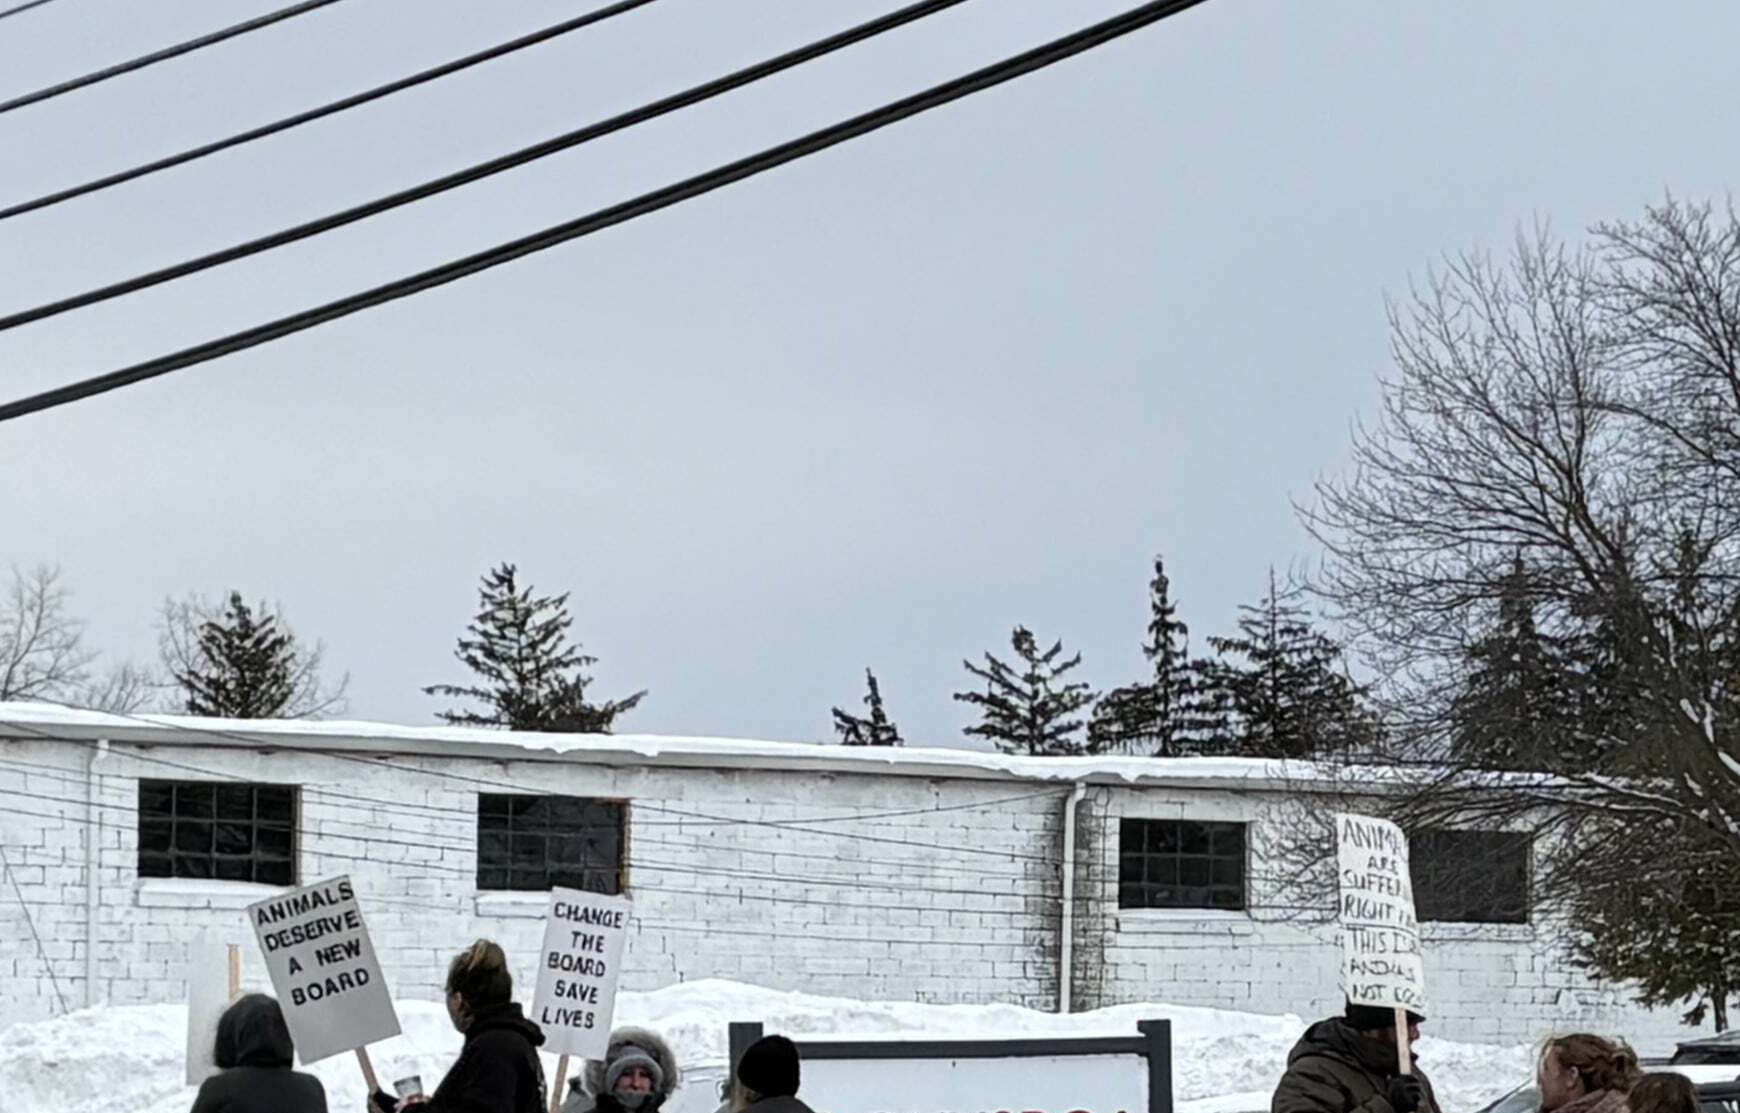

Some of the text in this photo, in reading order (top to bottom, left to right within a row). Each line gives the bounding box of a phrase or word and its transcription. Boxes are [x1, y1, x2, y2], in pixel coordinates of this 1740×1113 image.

[258, 882, 354, 926] ANIMALS
[554, 902, 623, 929] CHANGE
[1344, 894, 1395, 919] RIGHT
[264, 910, 360, 952] DESERVE
[572, 931, 604, 953] THE
[1346, 926, 1387, 953] THIS
[289, 938, 361, 975] A NEW
[547, 951, 606, 977] BOARD
[291, 967, 370, 1006] BOARD
[554, 980, 598, 1004] SAVE
[541, 1006, 595, 1029] LIVES
